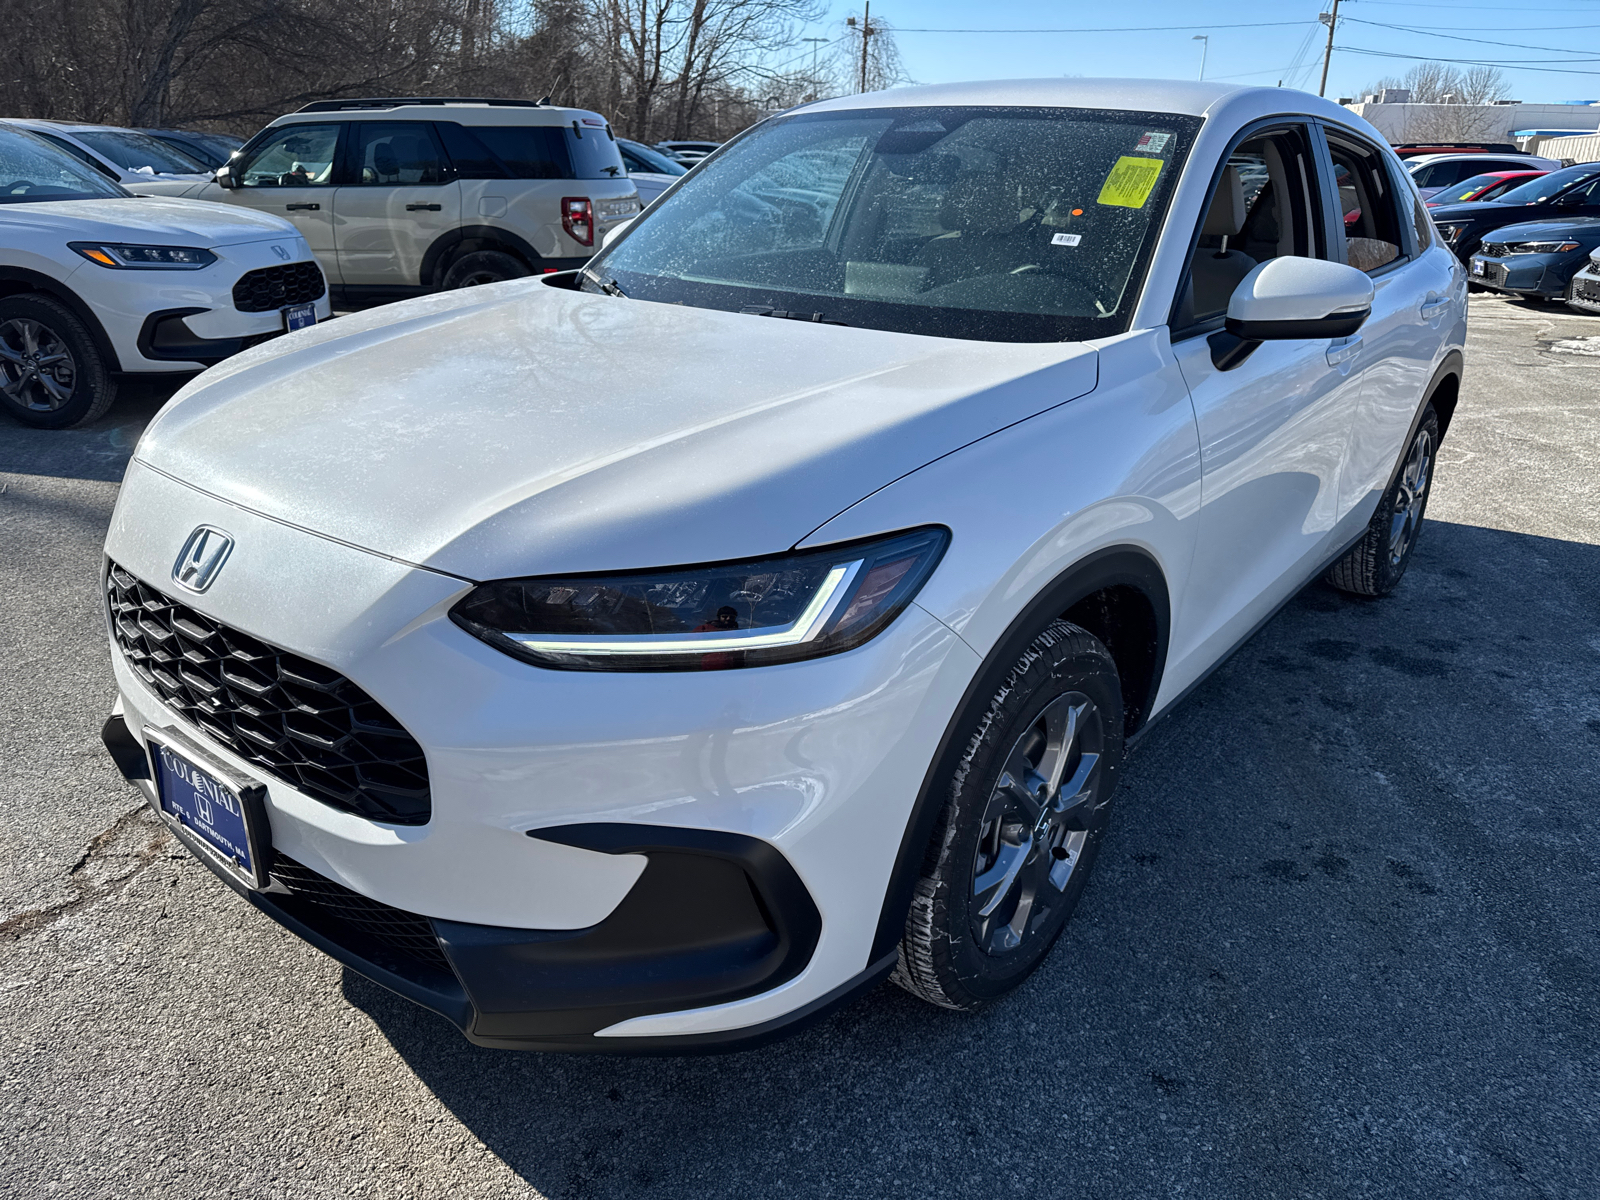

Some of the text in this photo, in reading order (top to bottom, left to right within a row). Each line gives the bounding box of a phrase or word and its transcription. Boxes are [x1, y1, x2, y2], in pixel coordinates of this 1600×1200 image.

[163, 751, 240, 817] COLONIAL
[194, 817, 235, 852] DARTMOUTH,
[235, 846, 246, 859] MA
